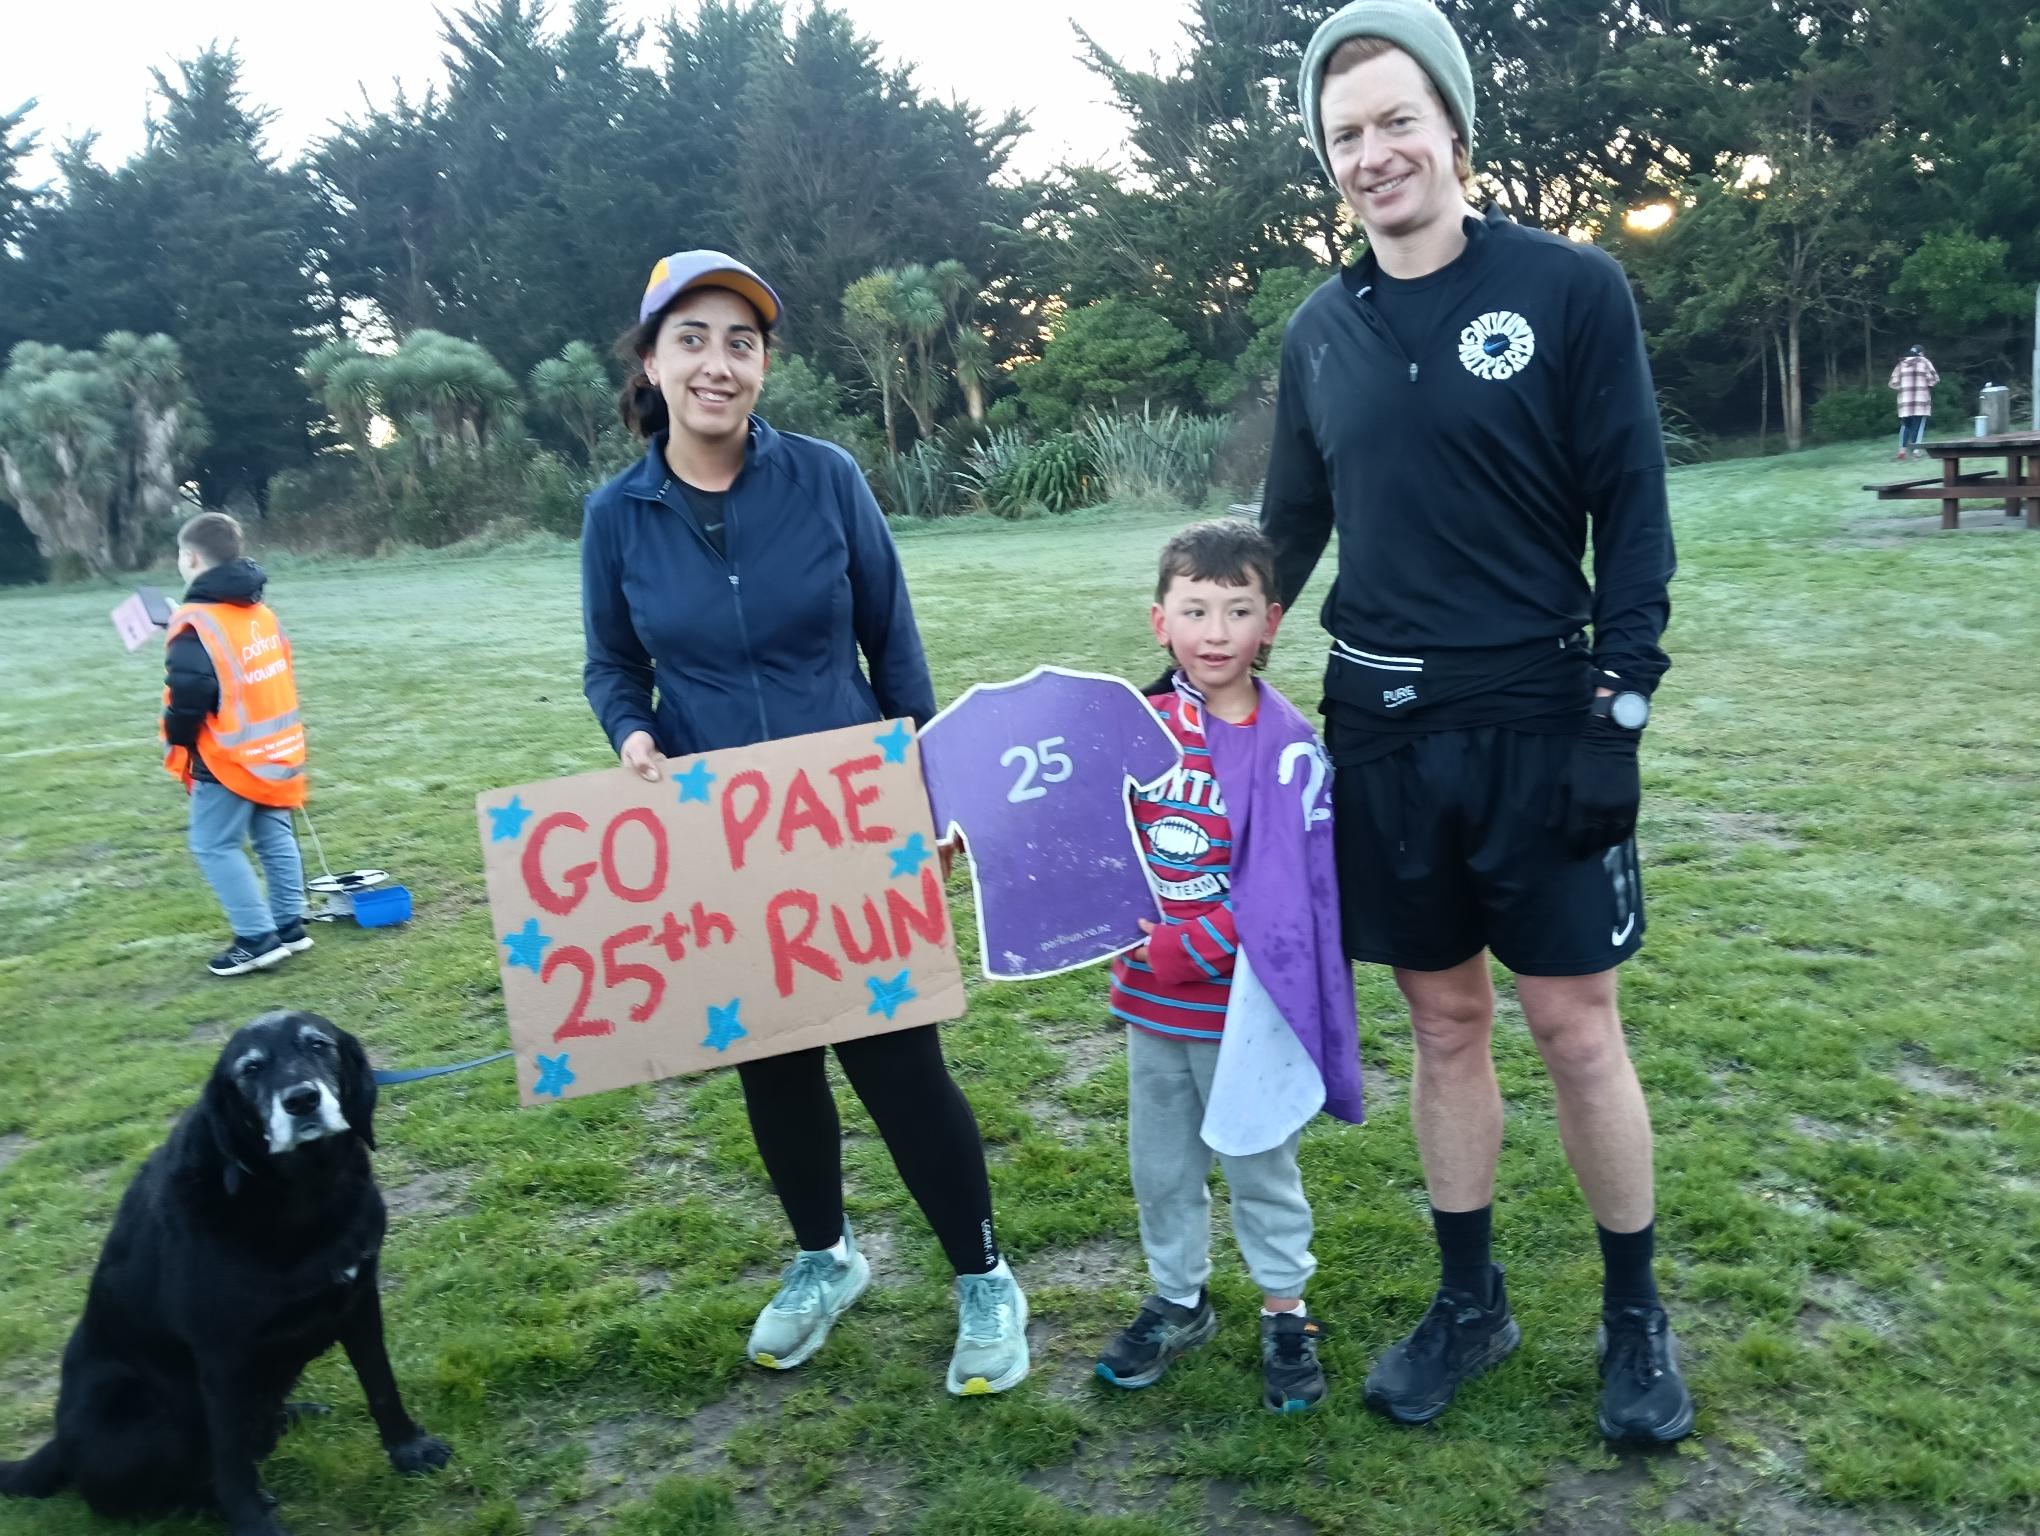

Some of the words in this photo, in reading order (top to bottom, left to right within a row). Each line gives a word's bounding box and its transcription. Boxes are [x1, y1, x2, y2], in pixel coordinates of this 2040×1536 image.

[1382, 685, 1416, 702] PURE
[999, 735, 1073, 803] 25
[521, 806, 669, 916] GO
[721, 755, 896, 871] PAE
[1174, 877, 1214, 896] TEAM
[540, 902, 737, 1043] 25th
[765, 867, 947, 998] RUN
